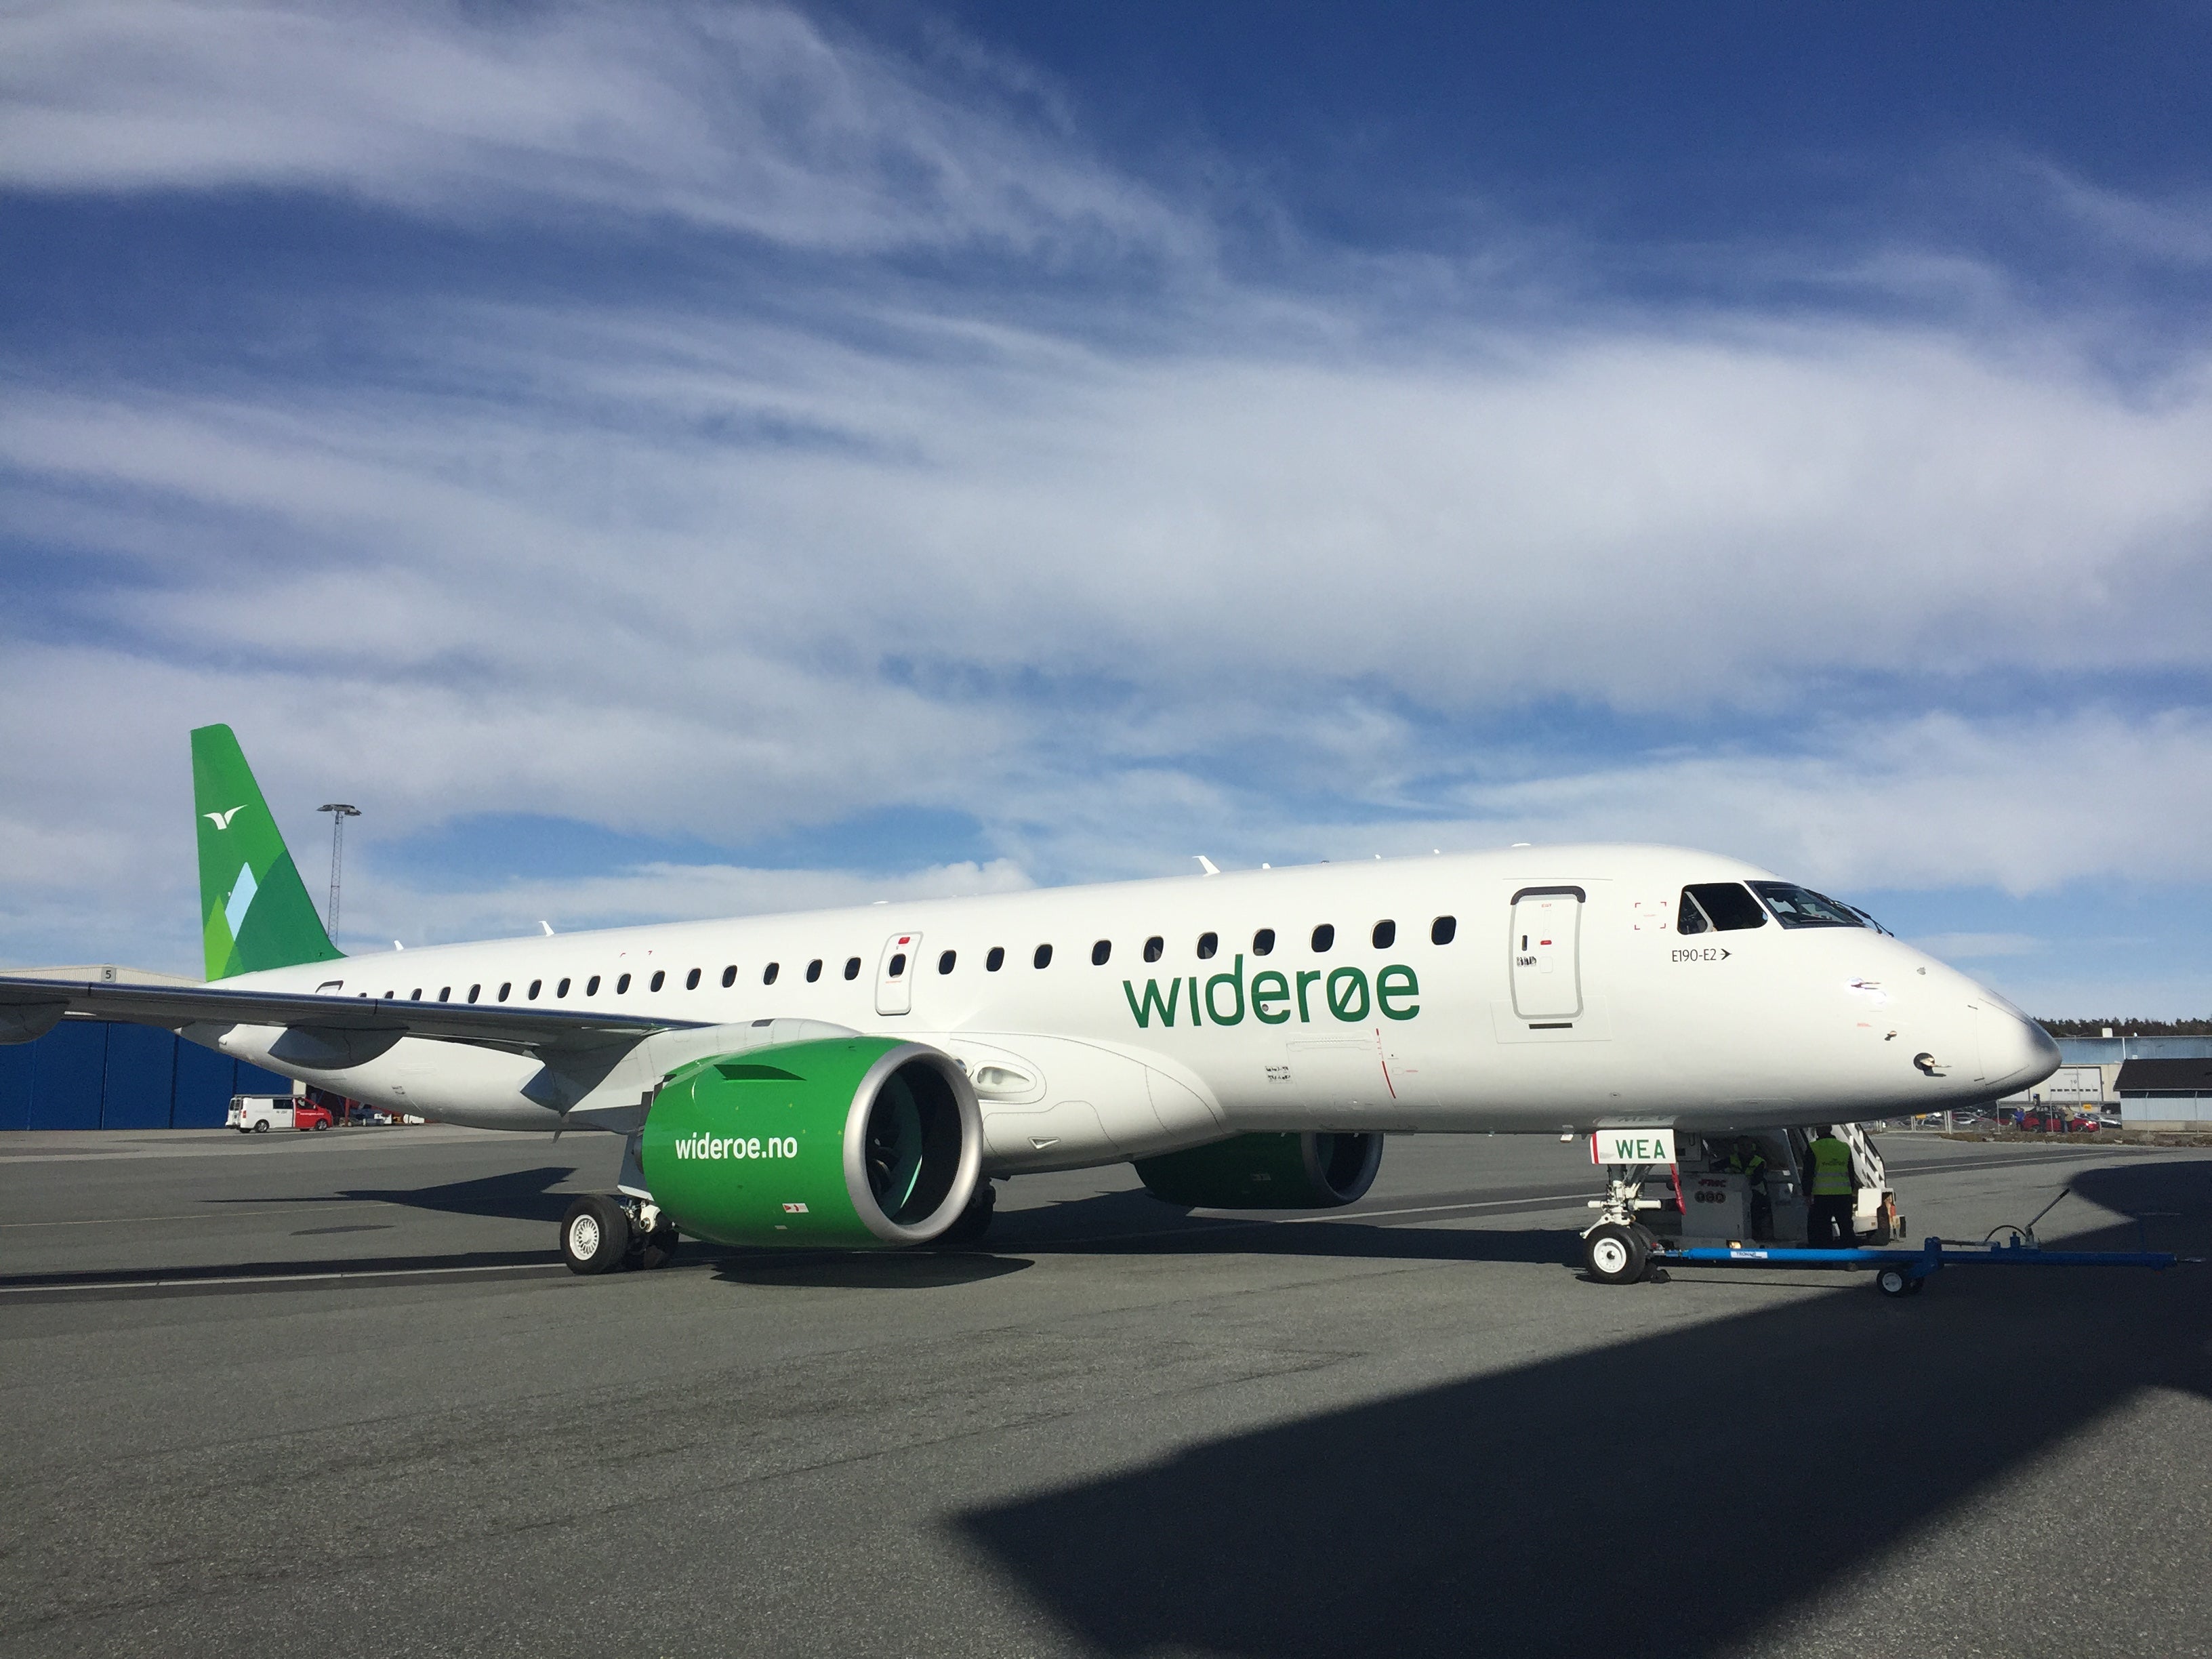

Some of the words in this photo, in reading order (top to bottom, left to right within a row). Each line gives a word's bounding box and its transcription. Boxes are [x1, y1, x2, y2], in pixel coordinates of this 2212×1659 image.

[1672, 948, 1717, 962] E190-E2
[105, 970, 112, 979] 5
[675, 1132, 798, 1160] wideroe.no
[1615, 1139, 1666, 1159] WEA
